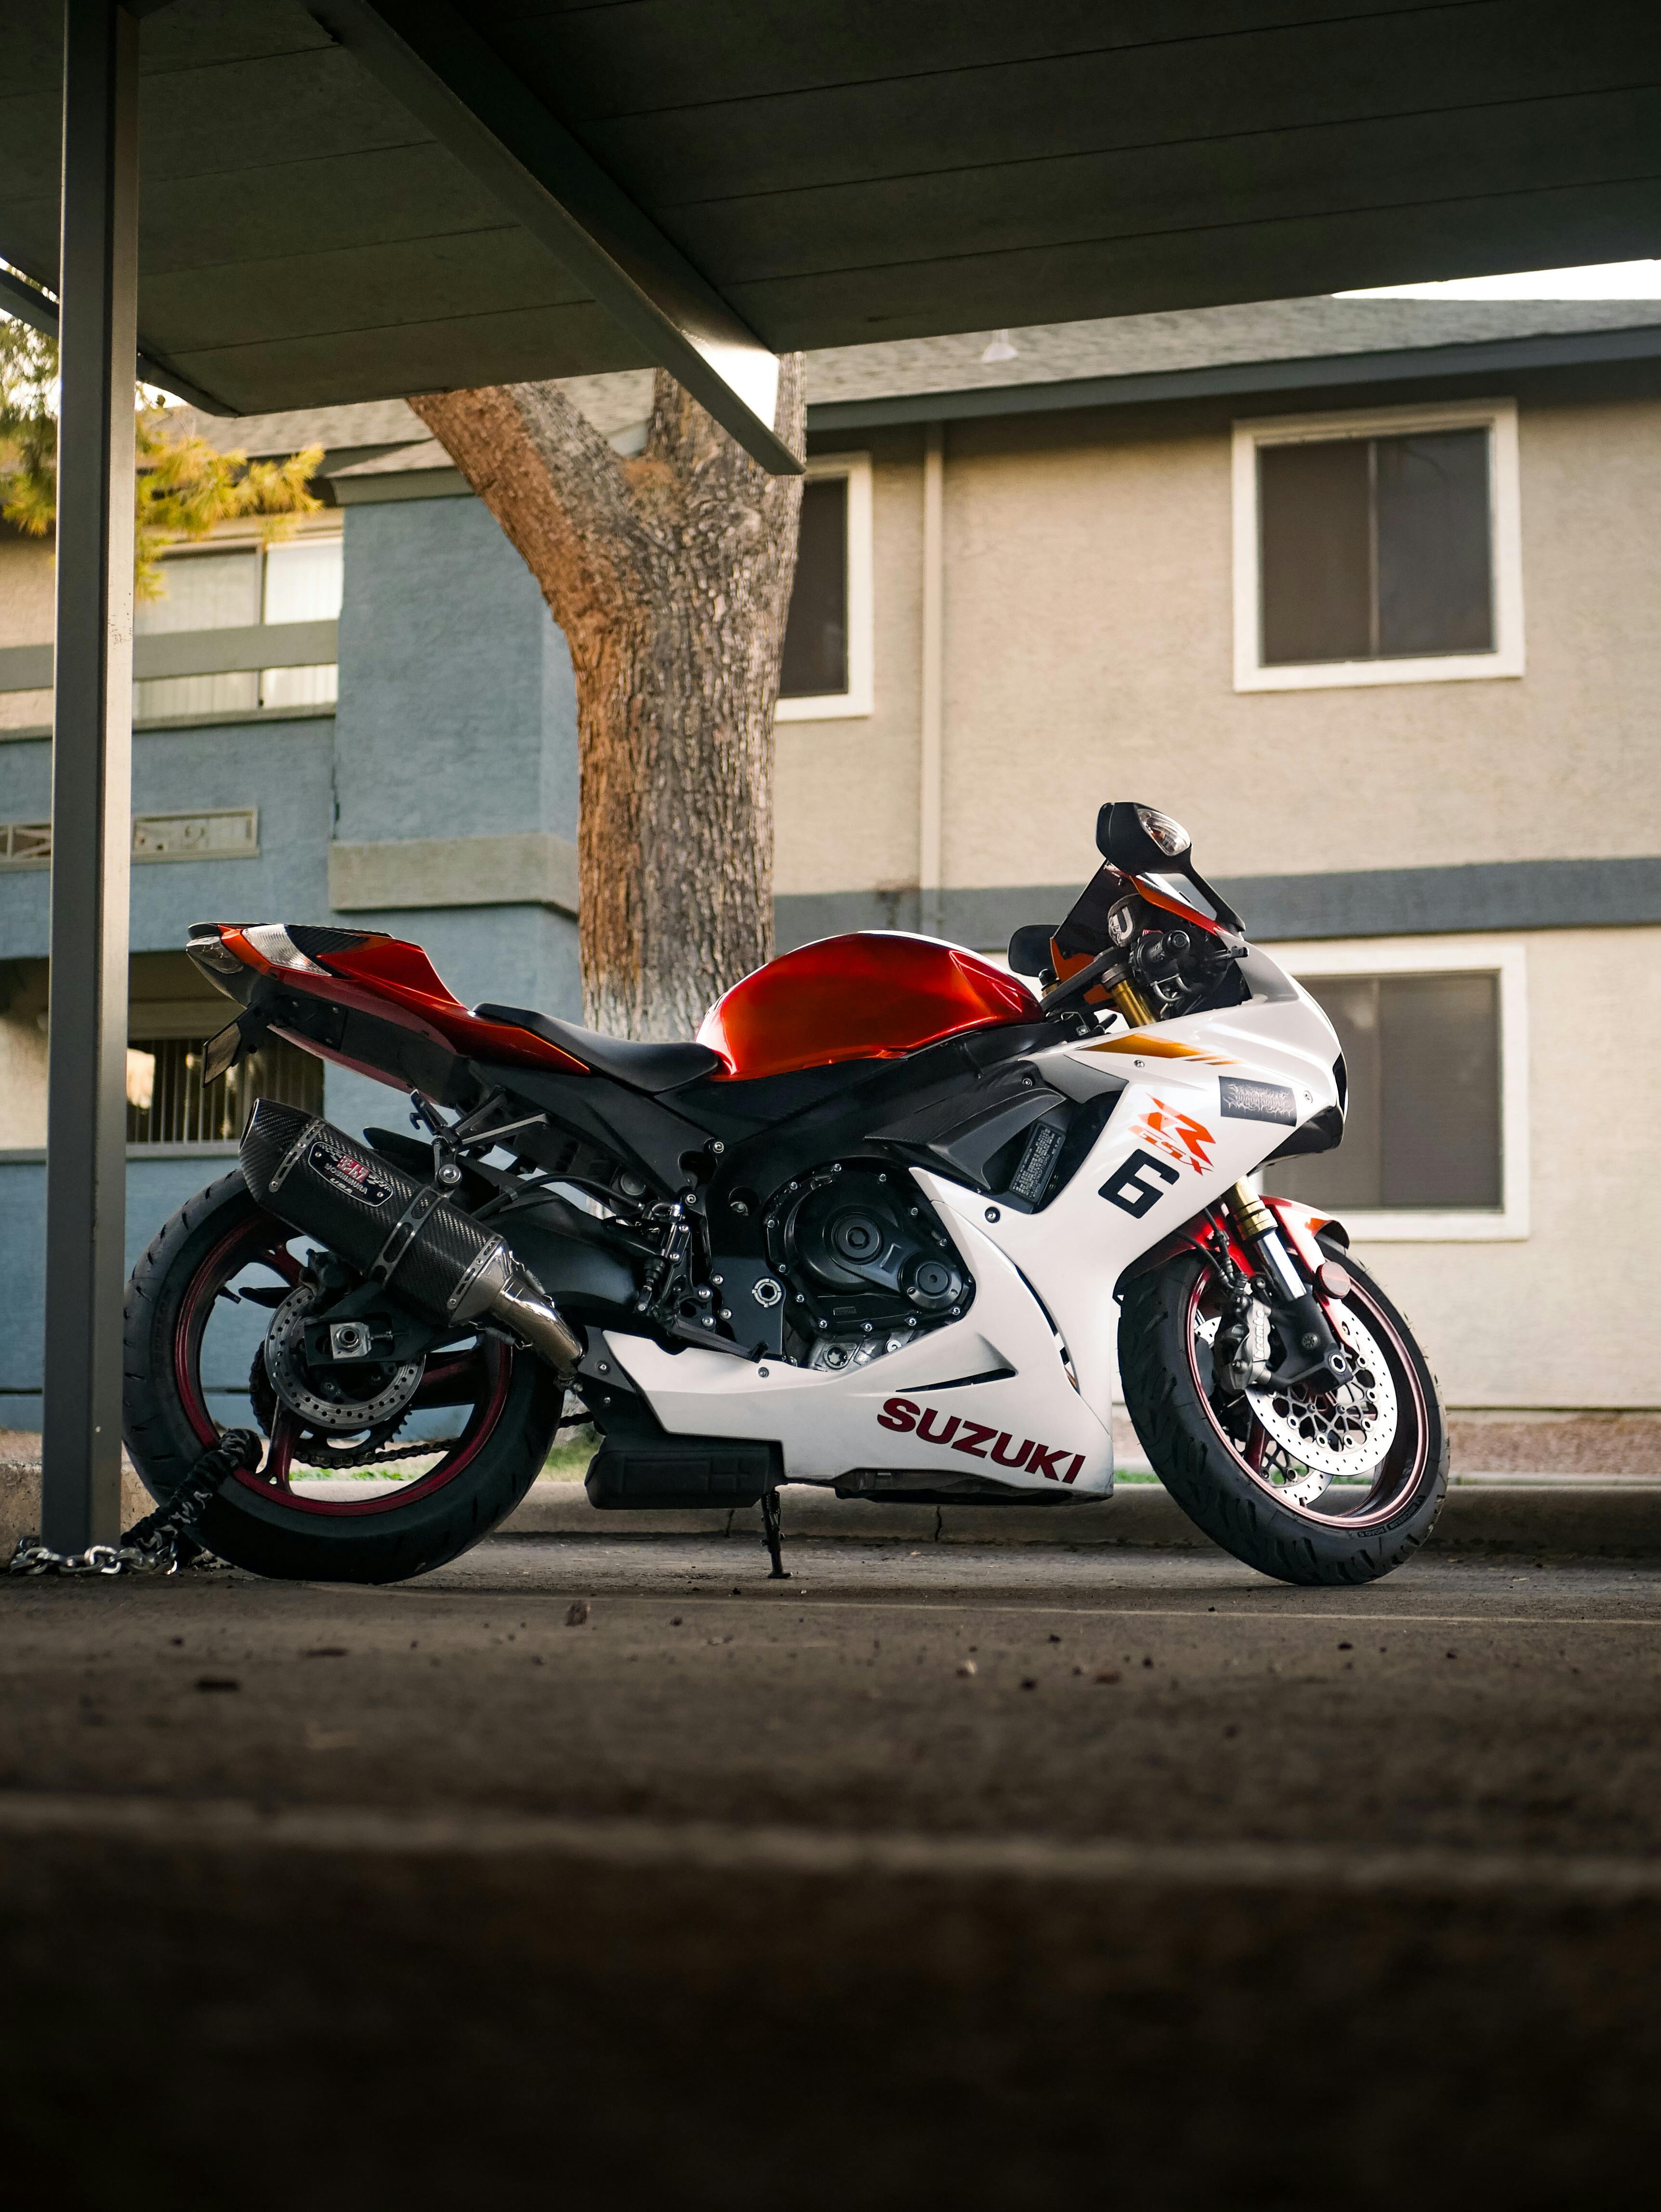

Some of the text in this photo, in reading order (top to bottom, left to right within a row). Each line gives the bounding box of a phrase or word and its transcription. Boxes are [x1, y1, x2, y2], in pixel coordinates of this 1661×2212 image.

[324, 1163, 368, 1194] YOSHIMURA
[330, 1178, 353, 1193] USA
[1098, 1148, 1180, 1219] 6
[1253, 1310, 1265, 1359] brembo
[877, 1397, 1086, 1485] SUZUKI
